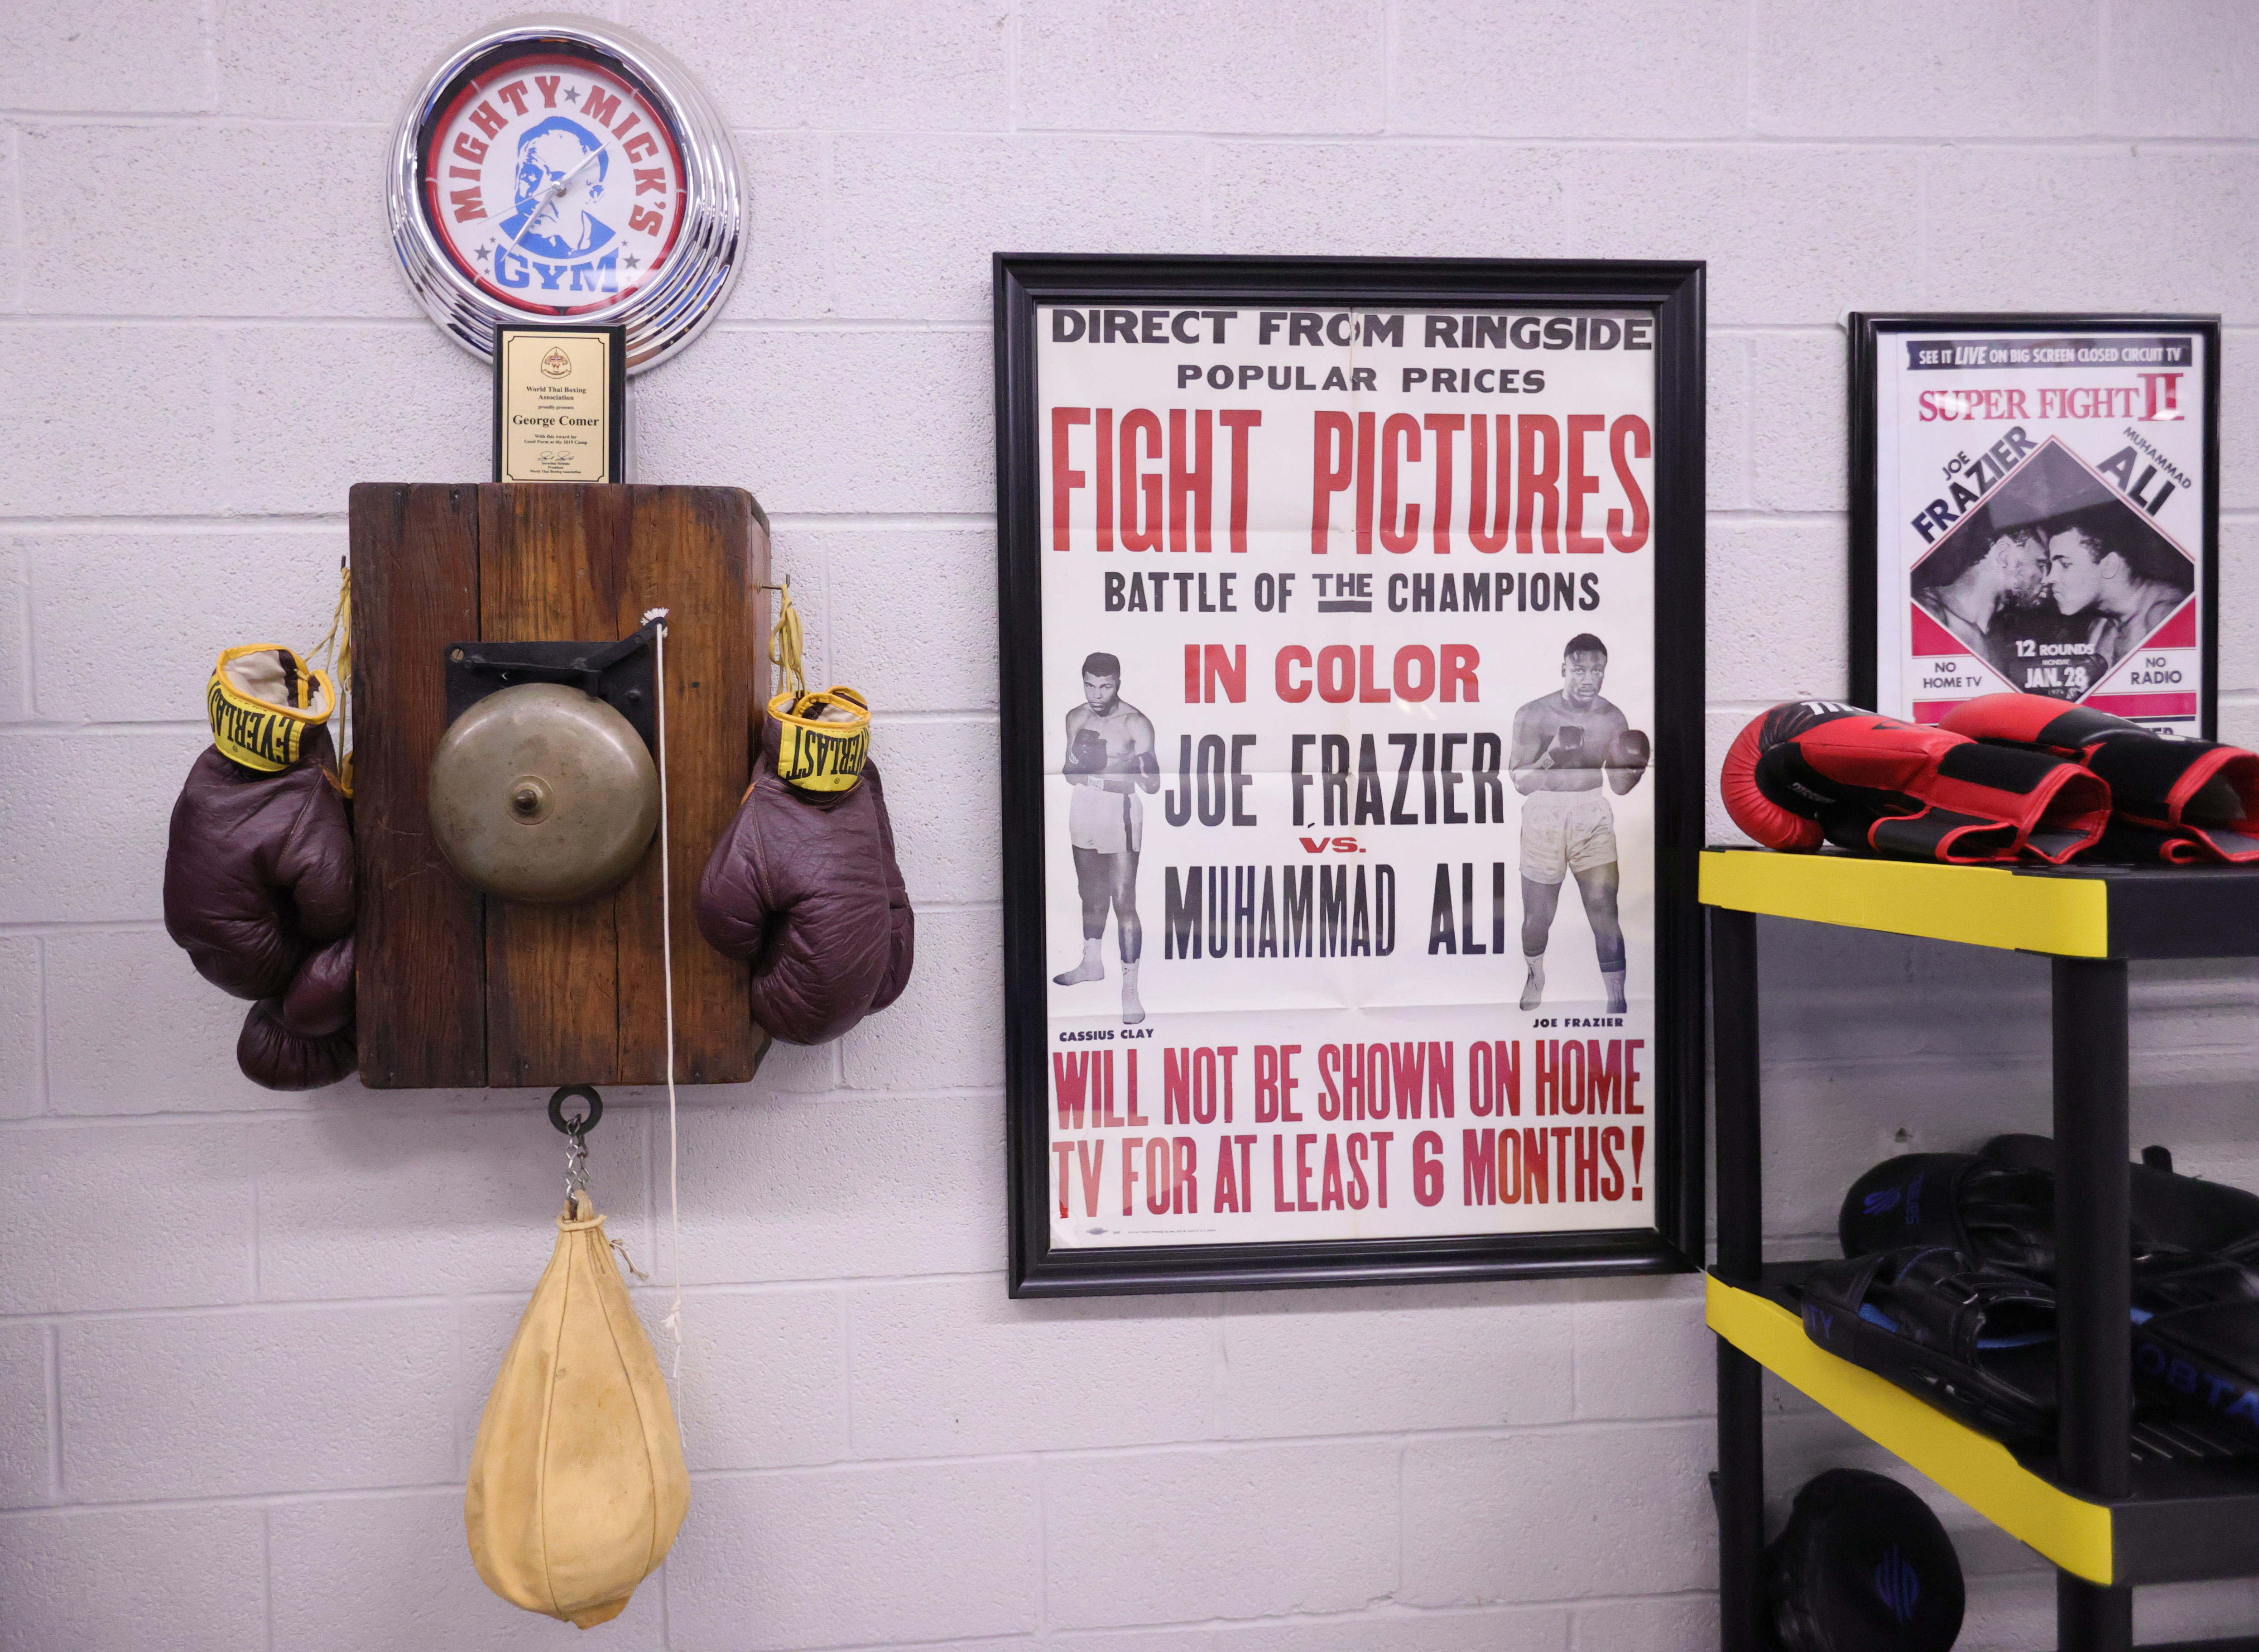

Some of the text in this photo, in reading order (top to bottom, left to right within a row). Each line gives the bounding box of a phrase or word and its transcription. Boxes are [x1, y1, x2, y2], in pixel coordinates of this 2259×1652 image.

[449, 76, 667, 237] MIGHTY MICK'S
[495, 244, 619, 293] GYM
[1052, 309, 1653, 351] DIRECT FROM RINGSIDE
[1919, 346, 2182, 365] SEE IT LIVE ON BIG SCREEN CLOSED CIRCUIT TV
[1177, 365, 1545, 394] POPULAR PRICES
[1919, 373, 2185, 422] SUPER FIGHT II
[513, 415, 599, 427] George Comer
[1942, 451, 1971, 481] JOE
[2123, 427, 2191, 489] MUHAMMAD
[1051, 407, 1652, 554] FIGHT PICTURES
[1910, 426, 2038, 544] FRAZIER
[2096, 446, 2176, 517] ALI
[1105, 571, 1600, 613] BATTLE OF THE CHAMPIONS
[1935, 662, 1956, 672] NO
[2015, 639, 2095, 657] 12 ROUNDS
[2146, 657, 2166, 668] NO
[1184, 644, 1480, 704] IN COLOR
[1923, 677, 1982, 688] HOME TV
[2064, 667, 2087, 687] 28
[2131, 670, 2182, 685] RADIO
[1165, 732, 1505, 827] JOE FRAZIER
[1298, 837, 1366, 854] VS.
[1164, 862, 1505, 960] MUHAMMAD ALI
[1059, 1029, 1154, 1042] CASSIUS CLAY
[1533, 1018, 1624, 1028] JOE FRAZIER
[1052, 1039, 1645, 1129] WILL NOT BE SHOWN ON HOME
[1052, 1125, 1645, 1219] TV FOR AT LEAST 6 MONTHS!
